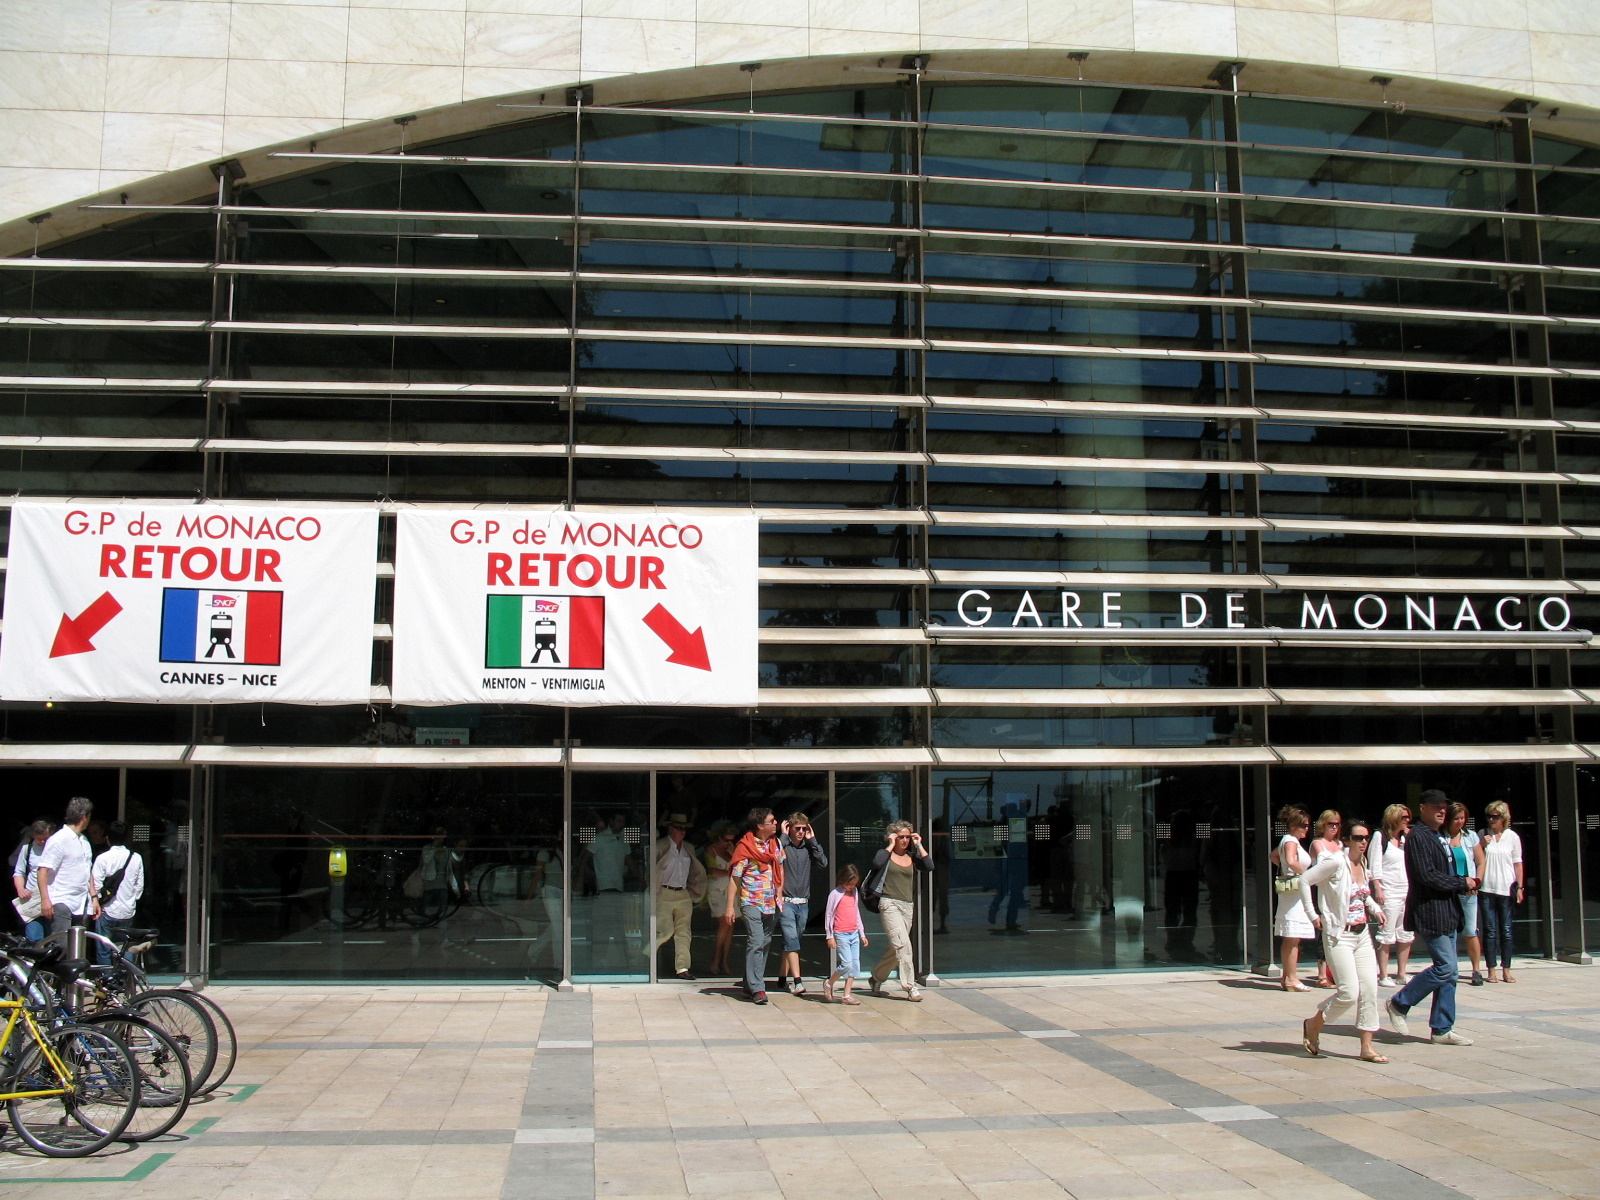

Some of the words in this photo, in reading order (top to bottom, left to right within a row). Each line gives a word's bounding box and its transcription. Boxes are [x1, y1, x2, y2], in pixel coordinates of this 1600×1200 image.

[64, 510, 116, 535] G.P
[127, 511, 162, 537] de
[176, 514, 321, 541] MONACO
[450, 519, 501, 544] G.P
[512, 519, 547, 545] de
[561, 522, 703, 549] MONACO
[99, 543, 283, 582] RETOUR
[487, 552, 667, 590] RETOUR
[213, 599, 236, 607] SNCF
[536, 604, 559, 612] SNCF
[957, 589, 1123, 628] GARE
[1180, 592, 1246, 629] DE
[1301, 593, 1572, 631] MONACO
[160, 672, 225, 686] CANNES
[242, 673, 278, 687] NICE
[482, 677, 526, 689] MENTON
[541, 678, 606, 691] VENTIMIGLIA
